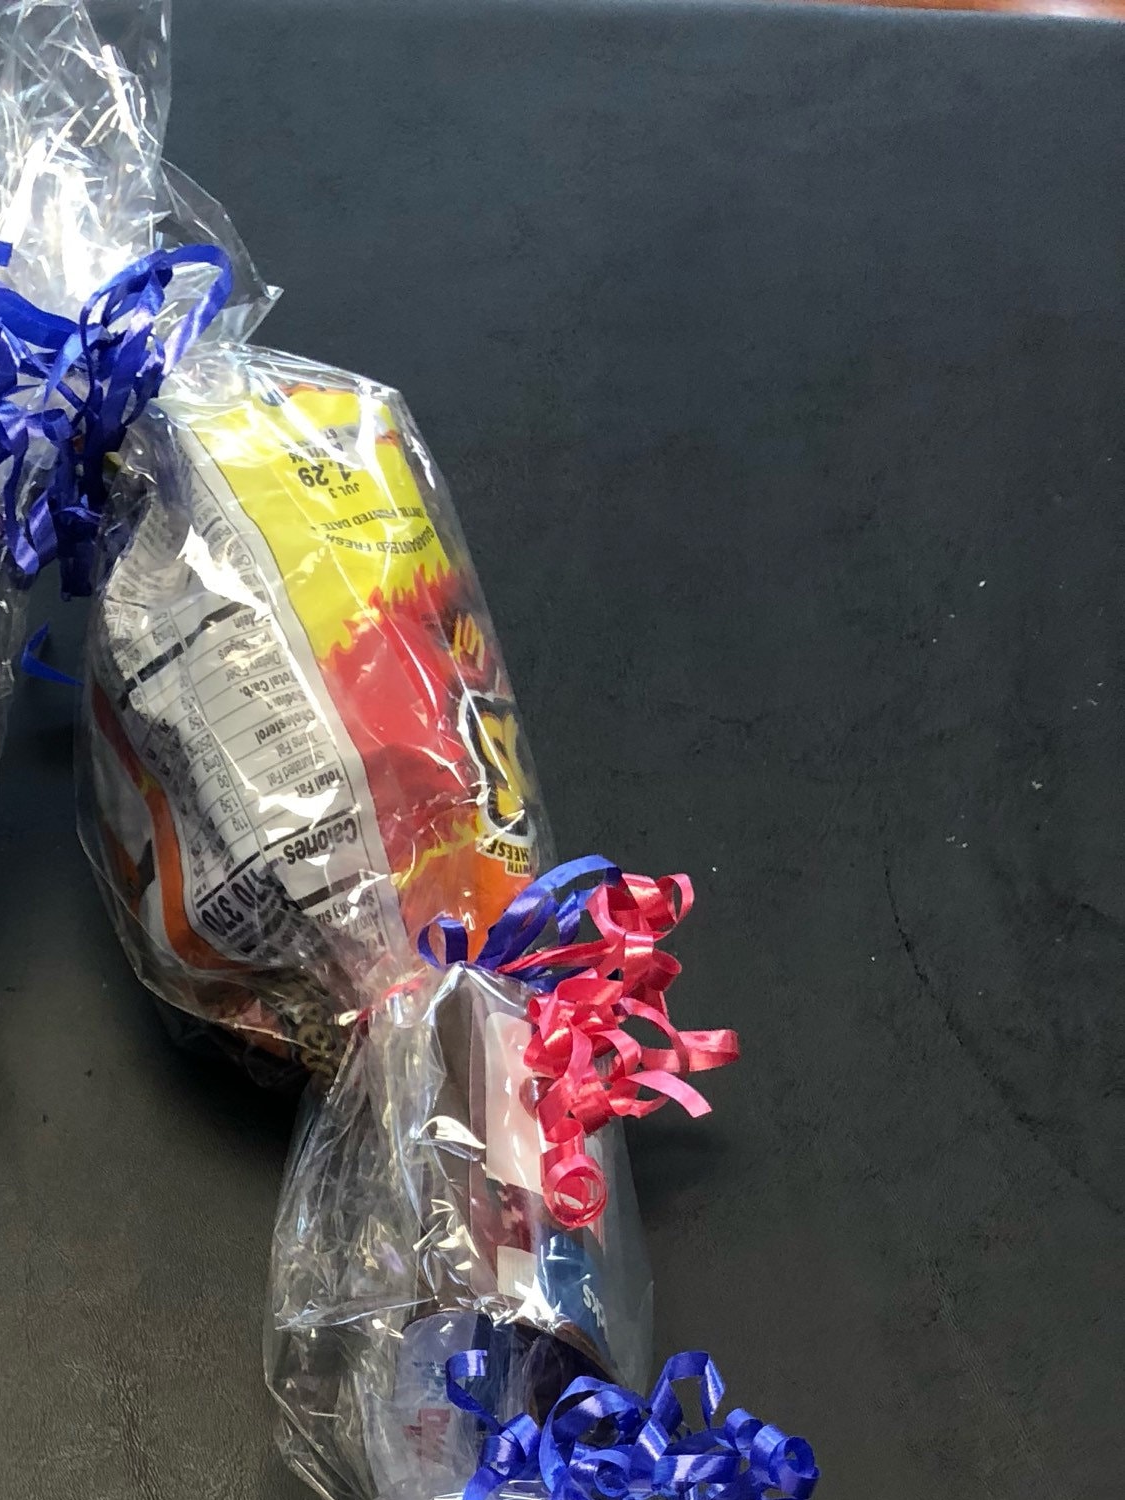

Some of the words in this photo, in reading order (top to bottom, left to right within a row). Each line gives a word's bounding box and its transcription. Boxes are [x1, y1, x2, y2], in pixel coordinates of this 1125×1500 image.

[297, 460, 352, 488] 1.29
[338, 482, 360, 497] JUL
[321, 519, 352, 531] DATE
[325, 533, 372, 552] FRESH
[376, 525, 435, 554] GUARANTEED
[225, 668, 250, 682] Fber
[254, 707, 316, 745] Cholesterol
[294, 783, 315, 798] Fat
[316, 767, 344, 794] Total
[282, 816, 359, 866] Calories
[485, 840, 530, 863] HEESE
